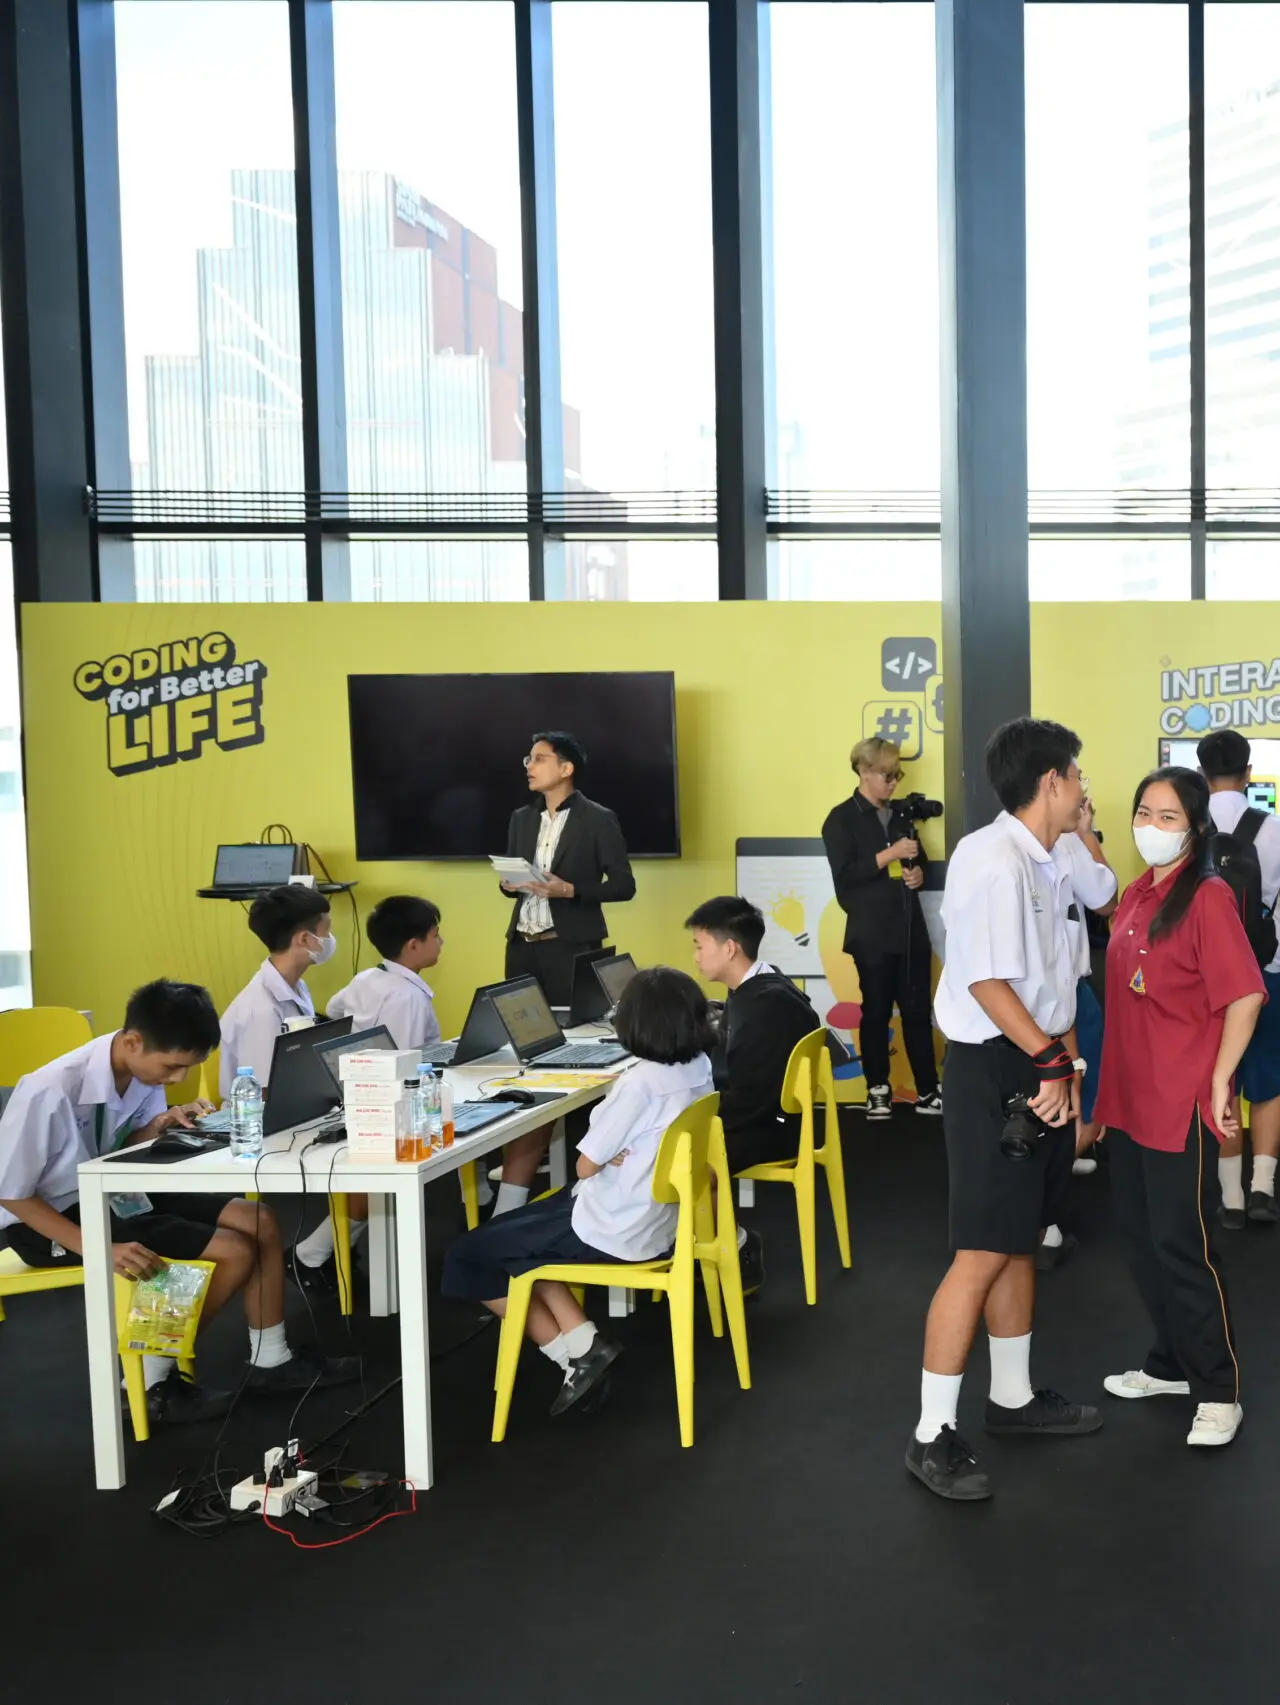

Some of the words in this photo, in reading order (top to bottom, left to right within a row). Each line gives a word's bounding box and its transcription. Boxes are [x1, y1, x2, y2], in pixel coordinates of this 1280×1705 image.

[74, 632, 233, 697] CODING
[107, 686, 154, 714] for
[160, 662, 259, 702] Better
[108, 683, 261, 773] LIFE
